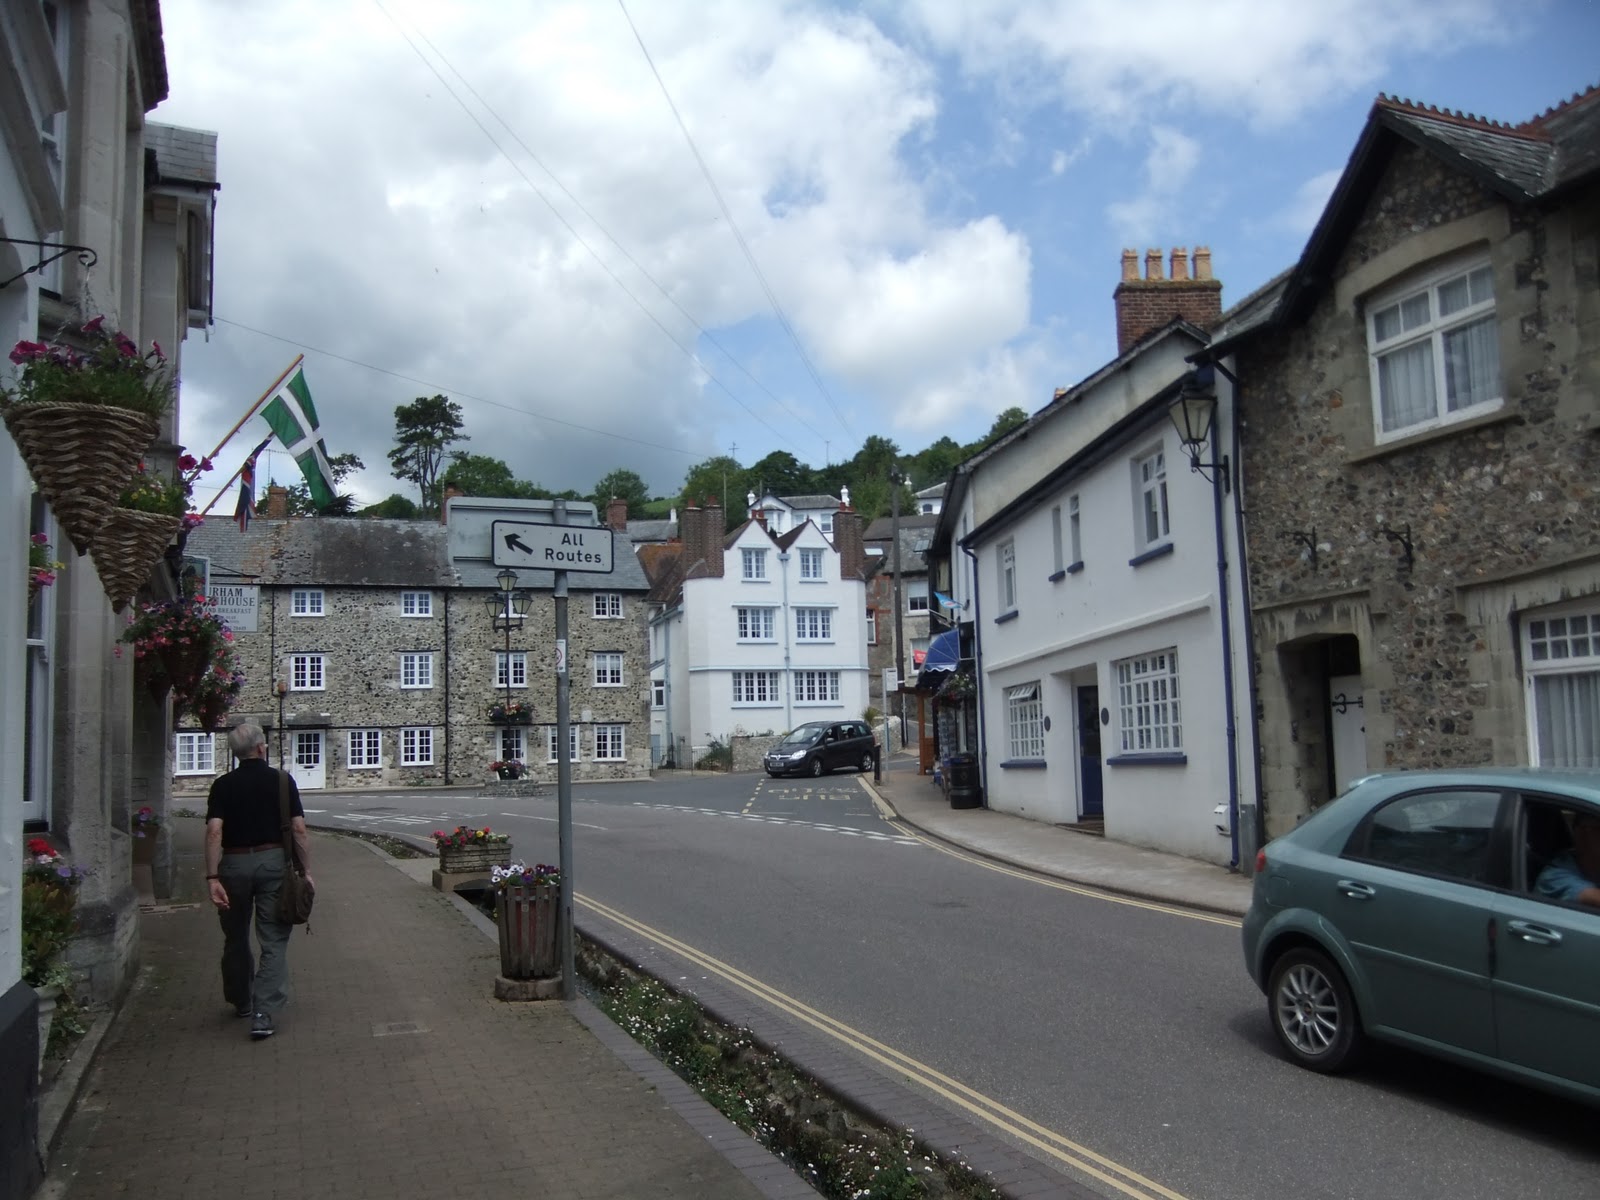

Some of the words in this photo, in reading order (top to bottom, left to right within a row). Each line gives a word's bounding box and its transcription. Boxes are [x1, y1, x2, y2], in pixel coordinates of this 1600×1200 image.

[561, 533, 584, 546] All
[545, 548, 602, 563] Routes
[220, 597, 255, 607] HOUSE
